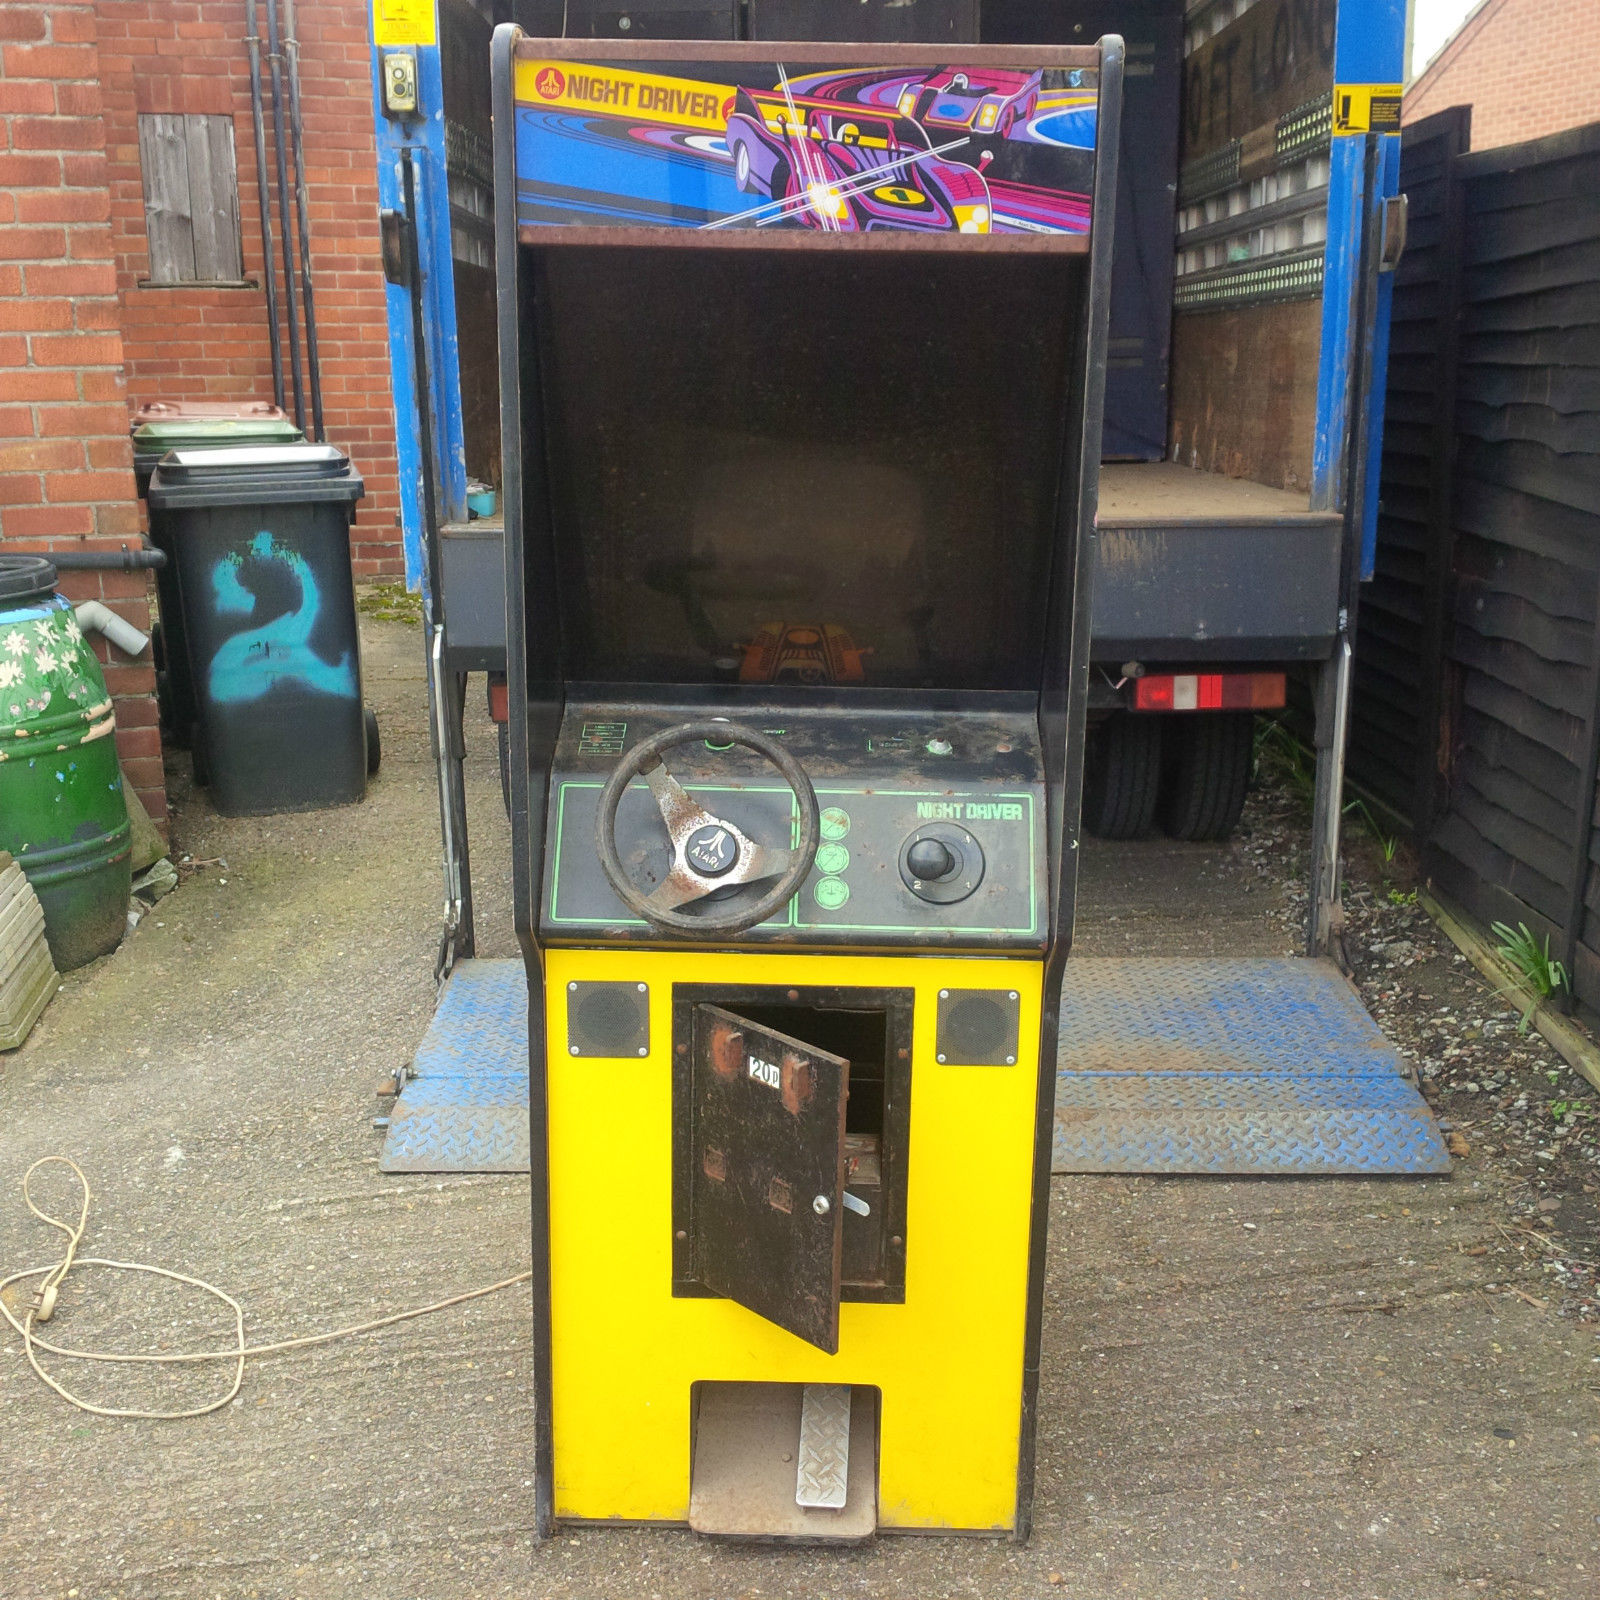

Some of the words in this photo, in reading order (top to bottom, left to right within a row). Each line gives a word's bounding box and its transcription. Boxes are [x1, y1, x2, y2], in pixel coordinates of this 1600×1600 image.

[540, 85, 560, 97] ATARI
[567, 74, 634, 106] NIGHT
[638, 84, 720, 120] DRIVER
[917, 802, 963, 819] NIGHT
[966, 803, 1023, 820] DRIVER
[913, 880, 922, 890] 2
